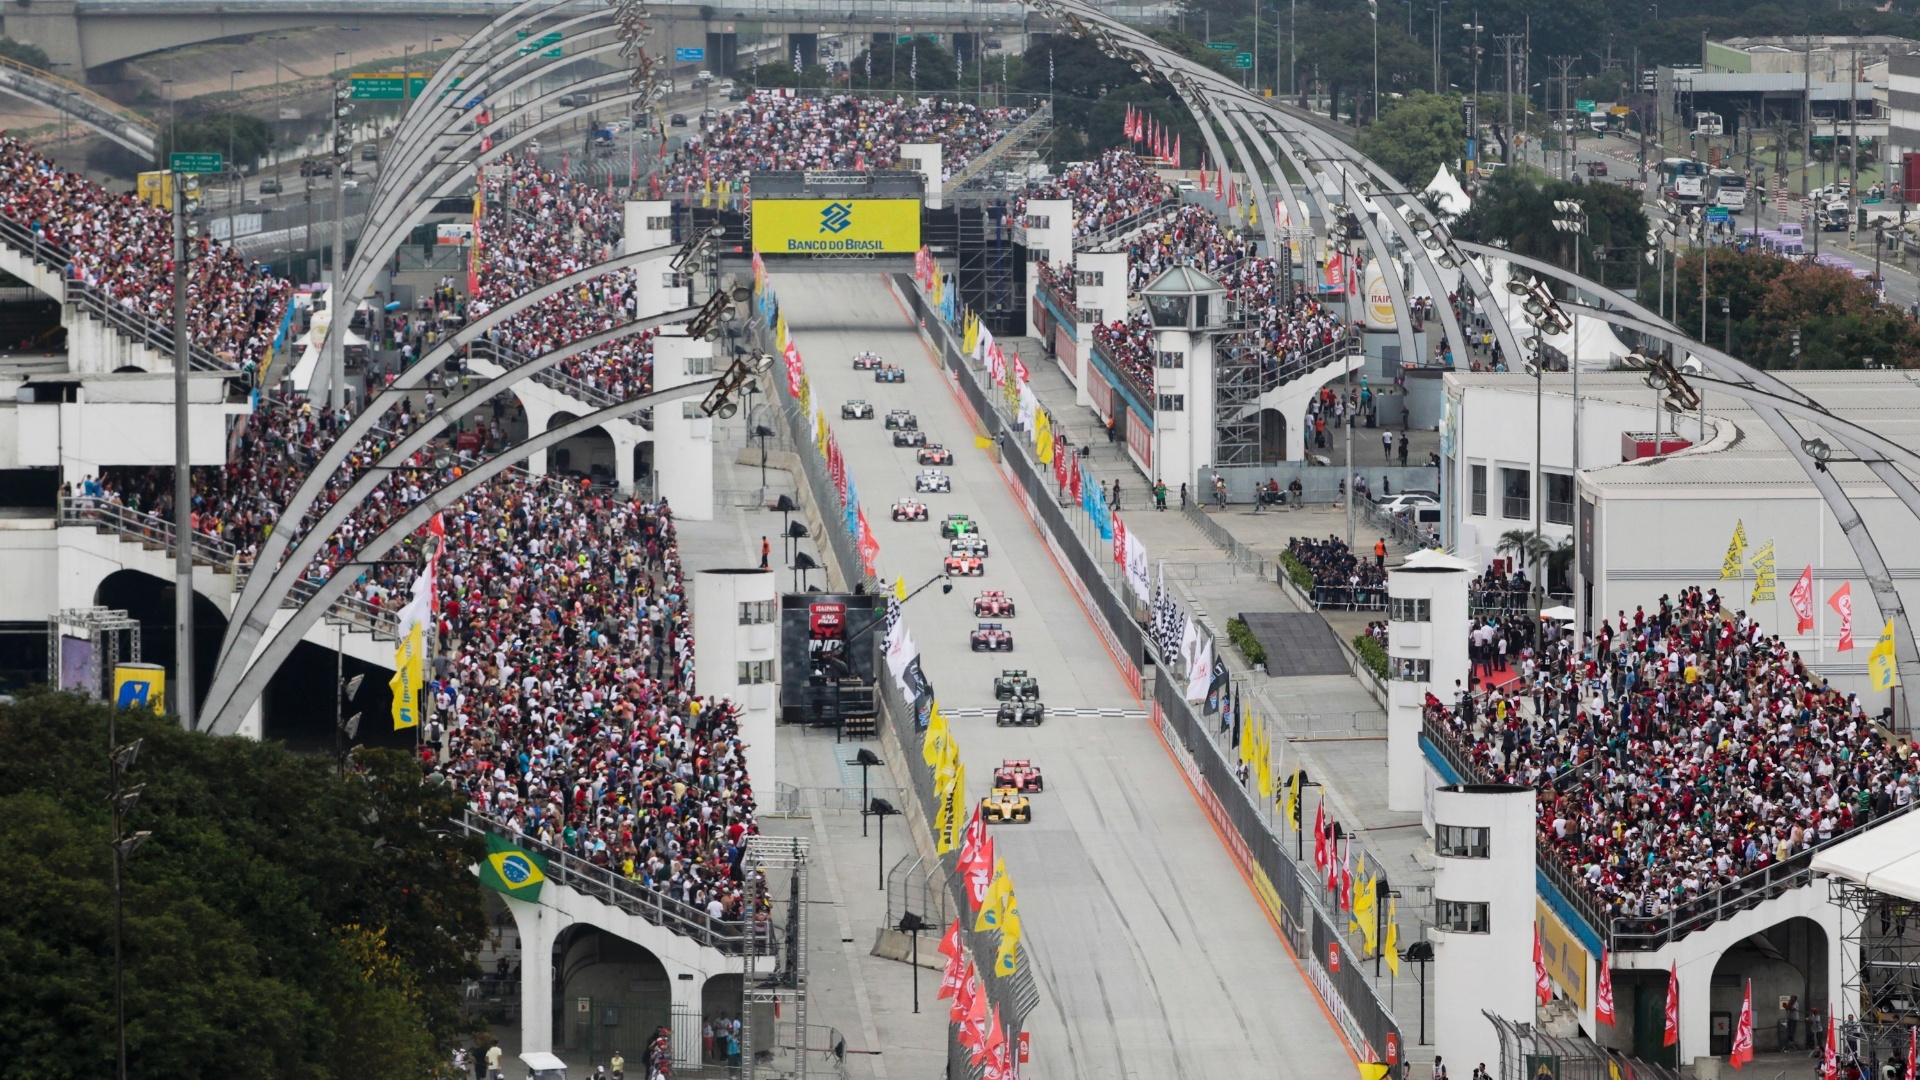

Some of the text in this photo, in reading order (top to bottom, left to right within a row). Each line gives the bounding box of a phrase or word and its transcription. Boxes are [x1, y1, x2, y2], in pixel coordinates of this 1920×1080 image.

[788, 239, 884, 250] BANCO DO BRASIL
[808, 640, 842, 652] IND
